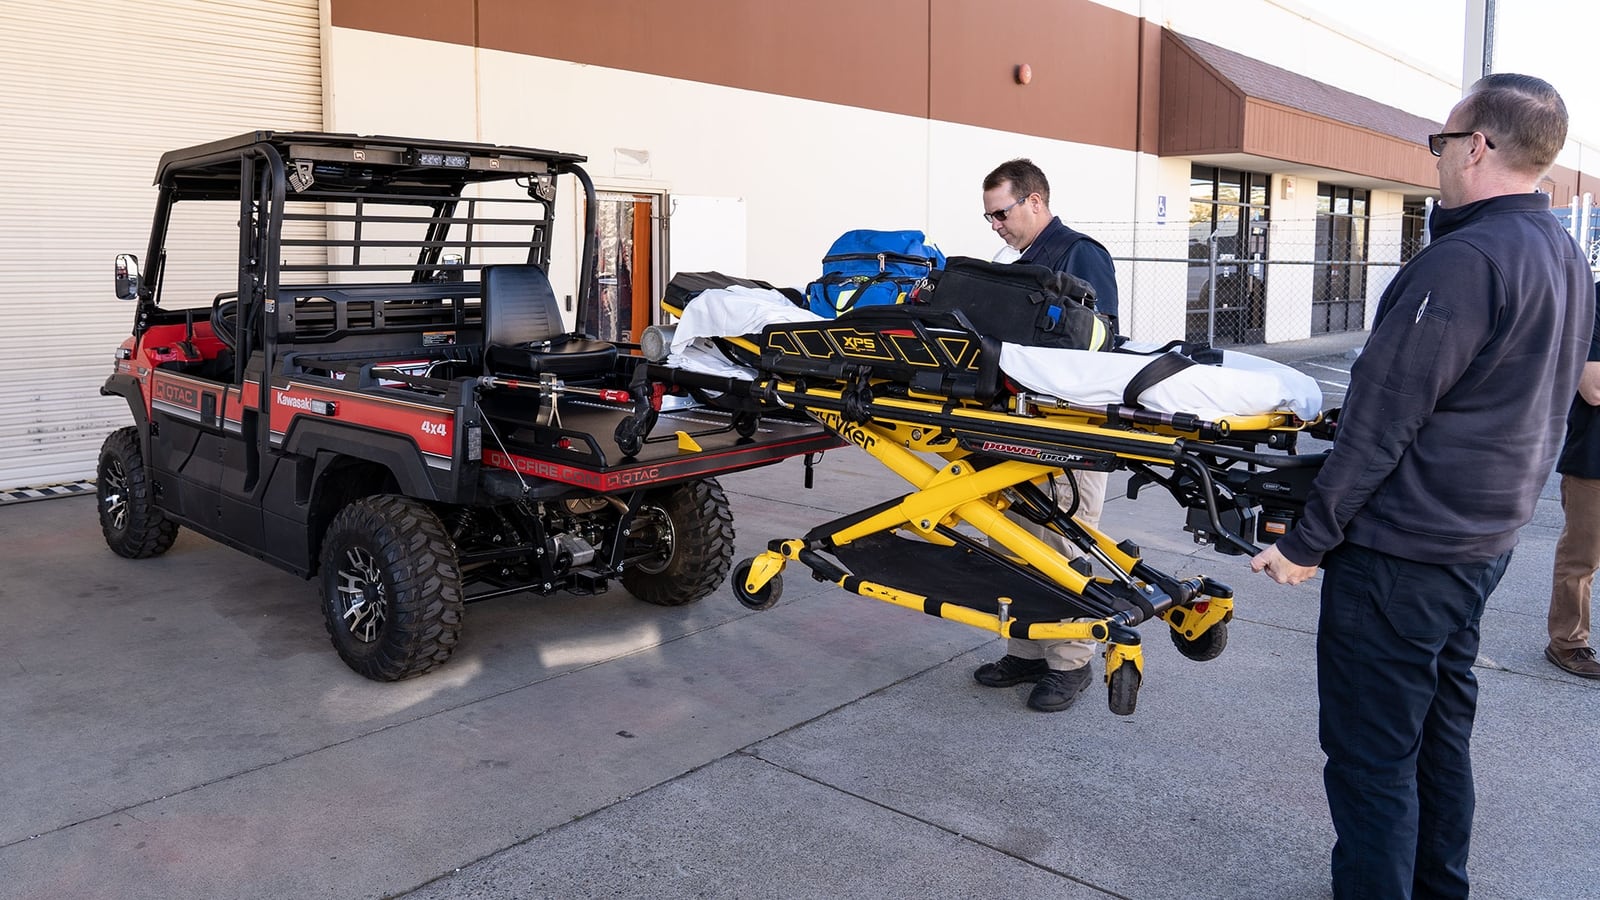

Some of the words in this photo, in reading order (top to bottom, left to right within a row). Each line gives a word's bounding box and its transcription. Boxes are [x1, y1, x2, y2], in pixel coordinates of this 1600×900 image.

[843, 336, 875, 349] XPS
[166, 385, 193, 403] QTAC
[276, 391, 312, 411] Kawasaki
[421, 420, 447, 437] 4x4
[621, 467, 659, 485] QTAC
